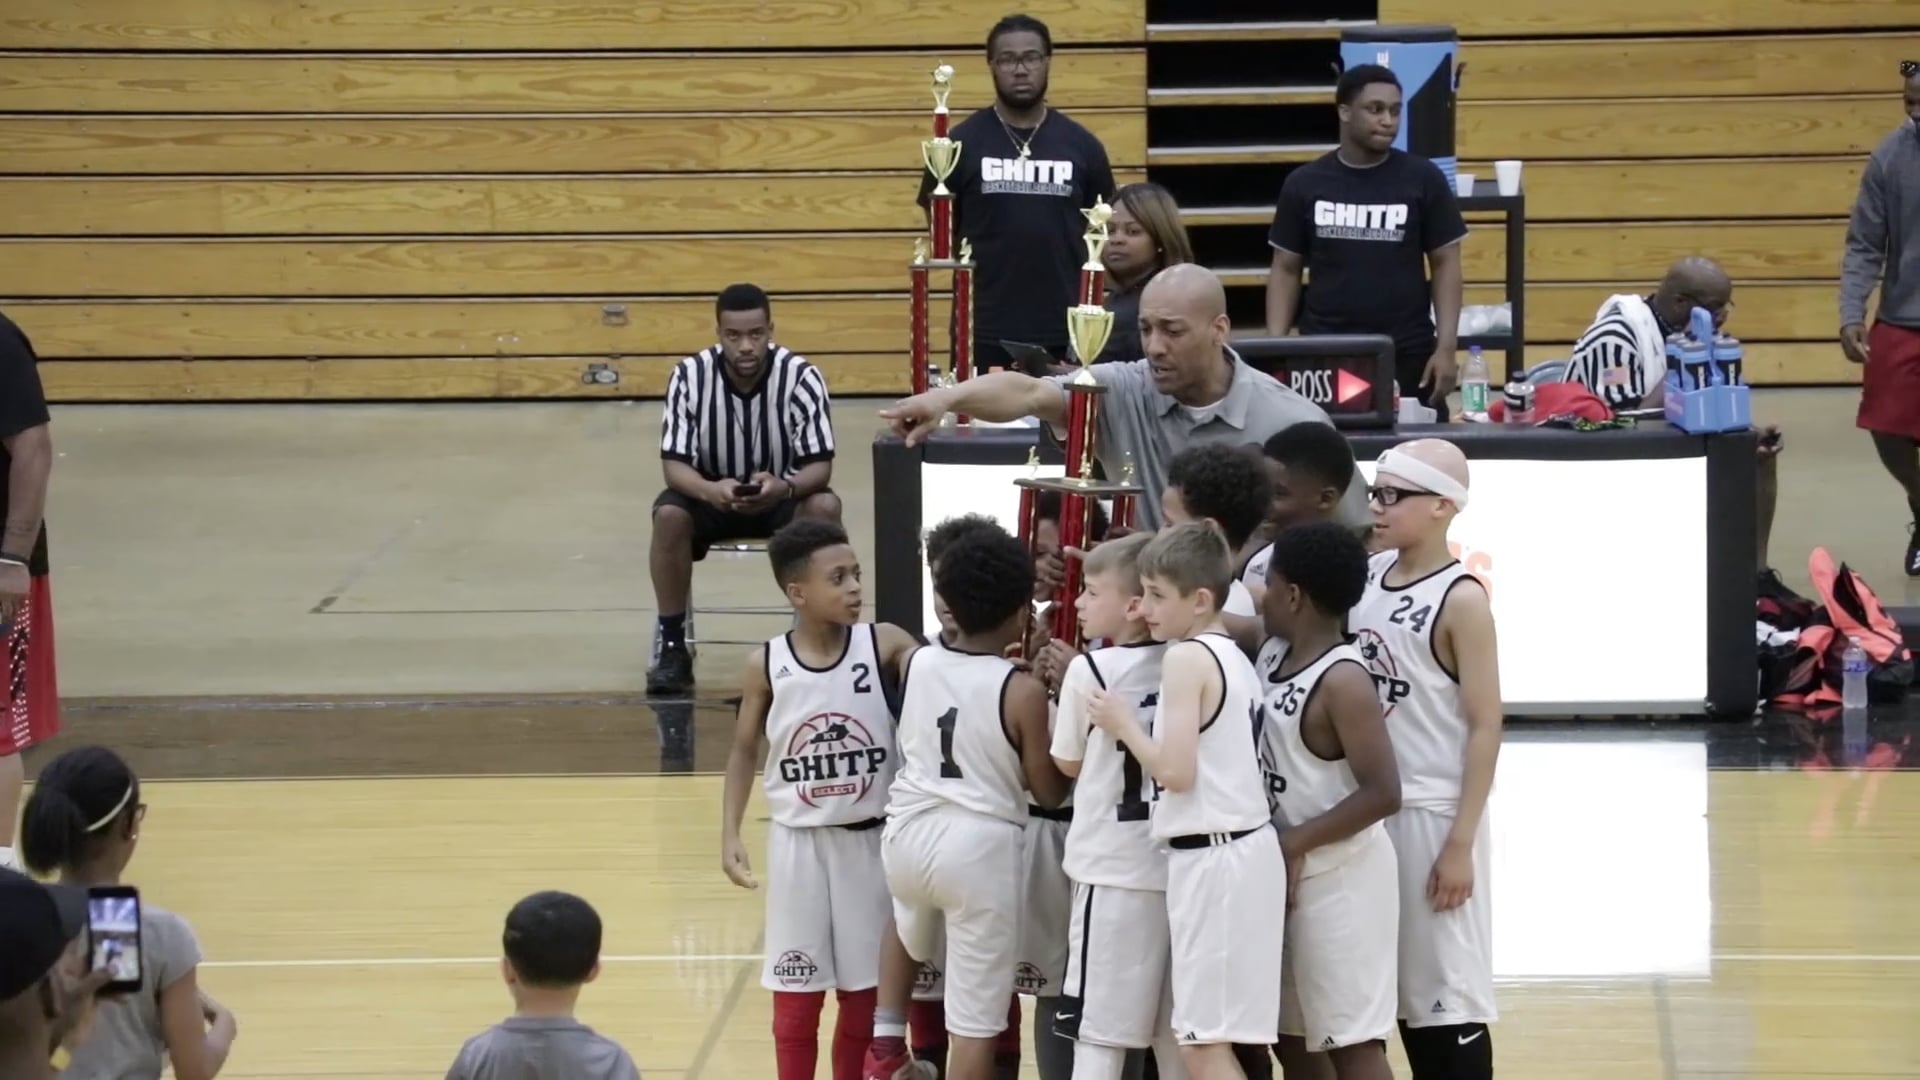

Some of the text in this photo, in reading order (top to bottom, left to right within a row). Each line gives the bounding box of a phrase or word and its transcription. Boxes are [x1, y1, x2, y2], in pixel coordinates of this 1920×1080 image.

[981, 156, 1073, 185] GHITP
[1314, 200, 1408, 230] GHITP
[1291, 369, 1333, 403] POSS
[1389, 595, 1432, 634] 24
[851, 662, 872, 694] 2
[1273, 682, 1306, 717] 35
[936, 707, 964, 779] 1
[780, 747, 887, 783] GHITP
[774, 965, 818, 977] GHITP
